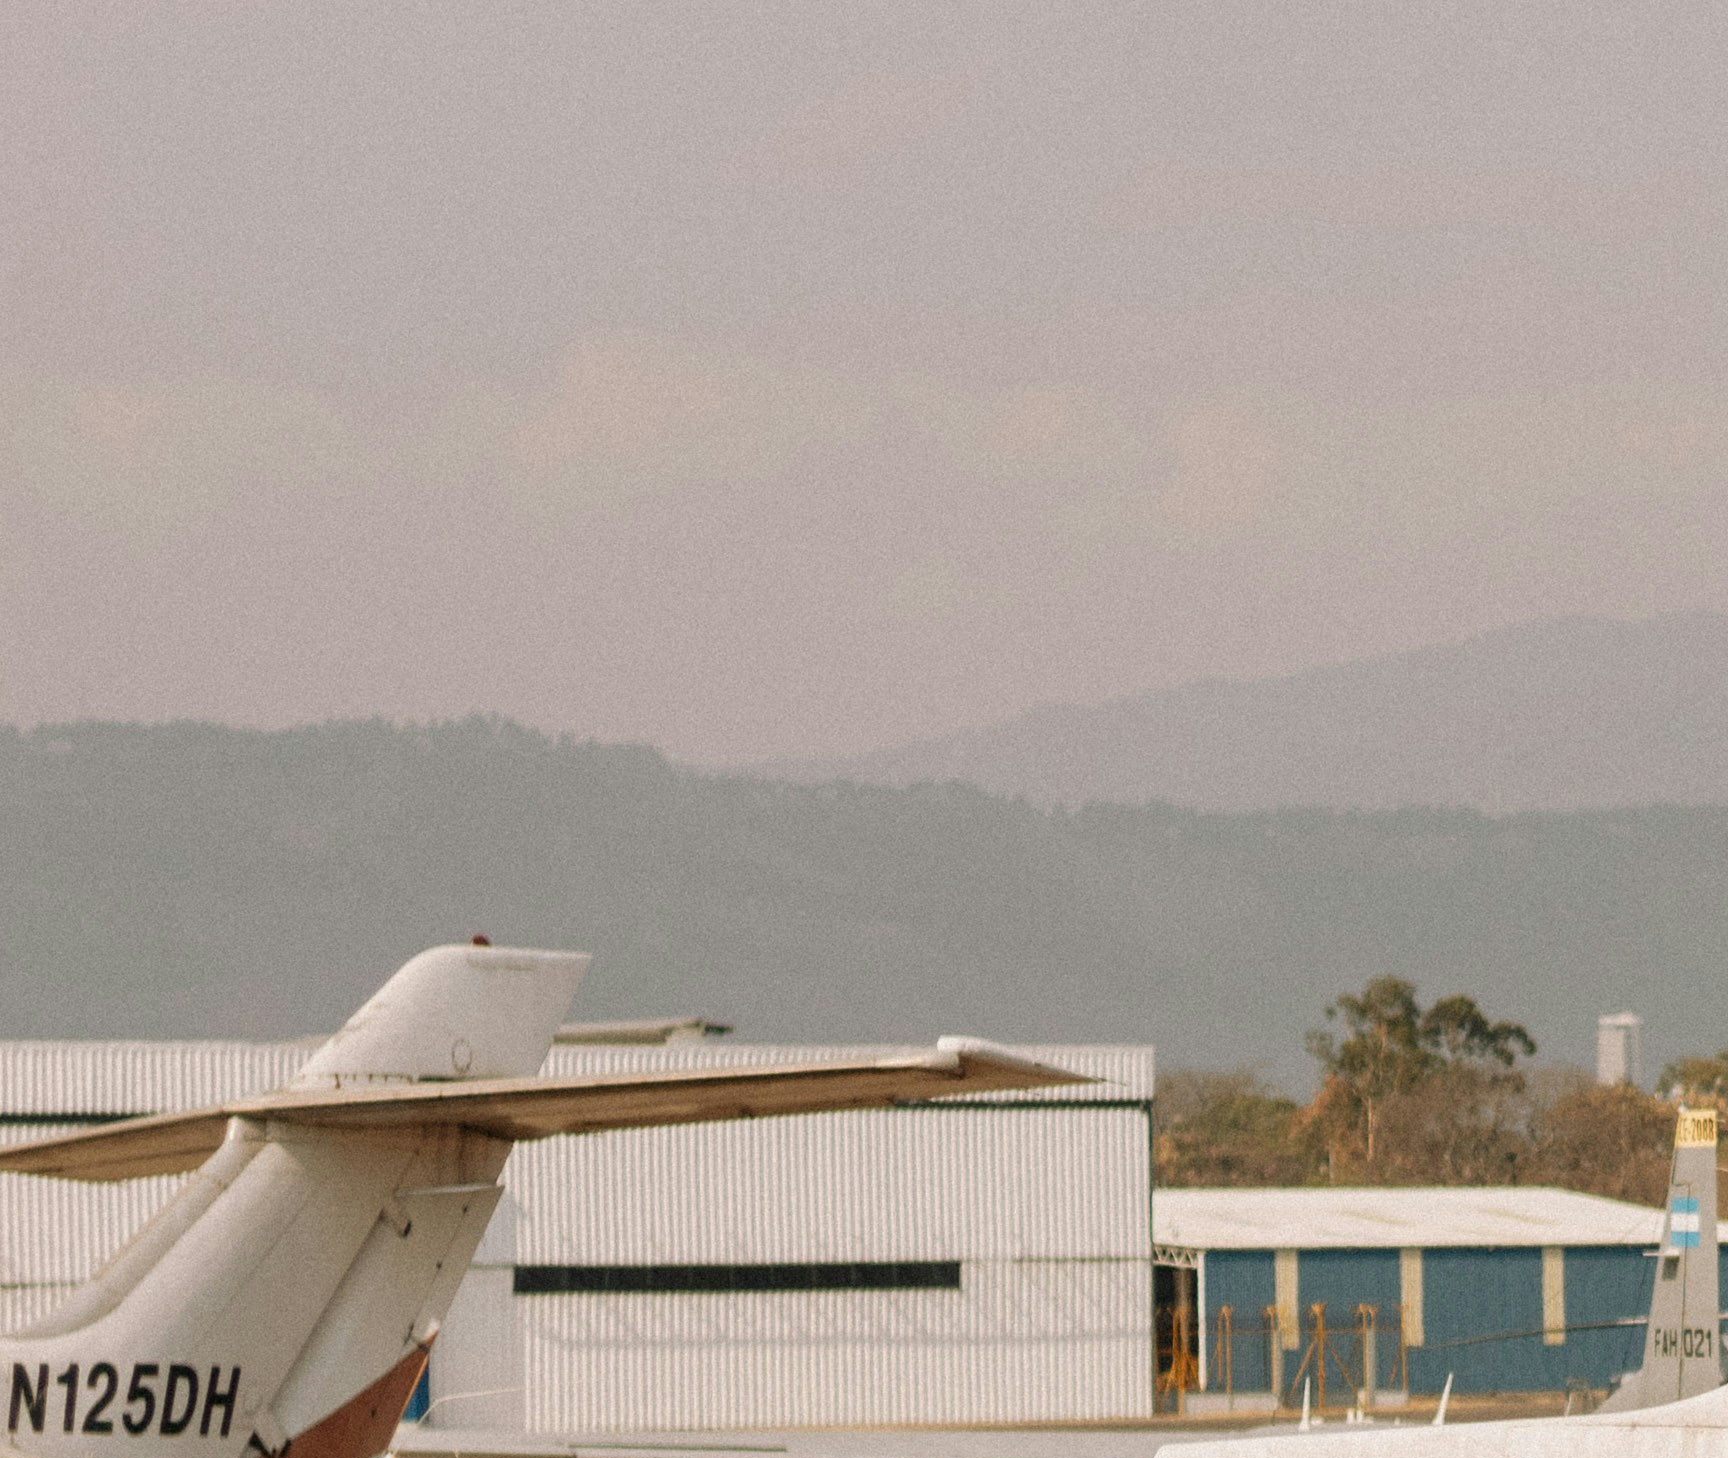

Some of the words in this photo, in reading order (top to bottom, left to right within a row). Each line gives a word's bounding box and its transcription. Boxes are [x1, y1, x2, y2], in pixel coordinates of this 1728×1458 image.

[1655, 1328, 1677, 1358] FAH
[1683, 1328, 1712, 1358] 021
[8, 1362, 242, 1437] N125DH
